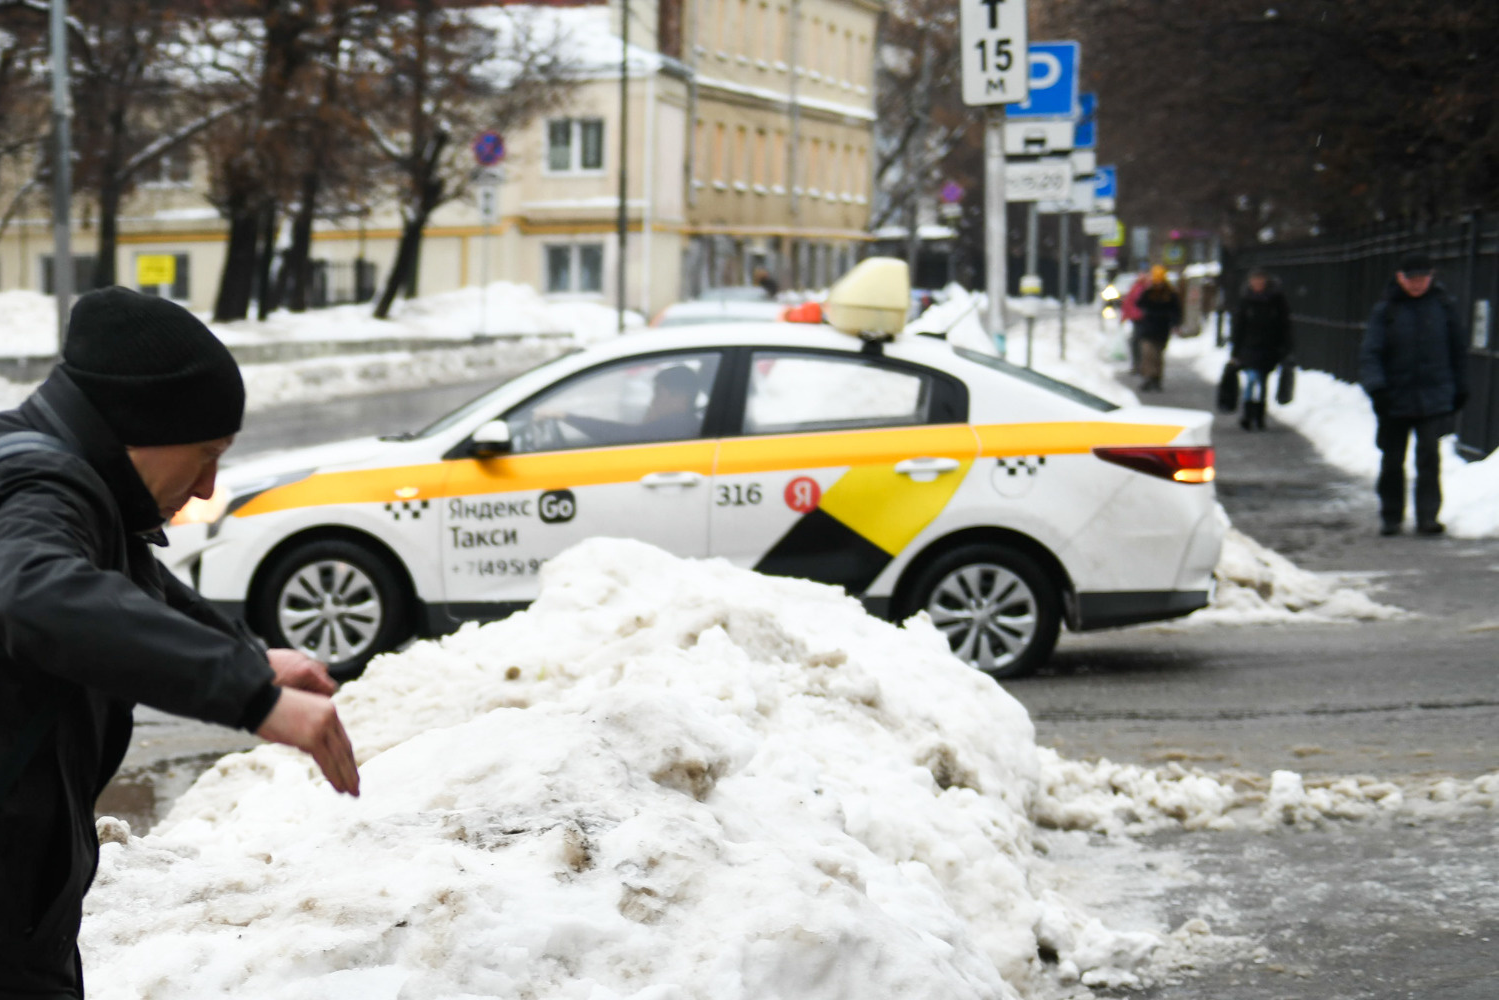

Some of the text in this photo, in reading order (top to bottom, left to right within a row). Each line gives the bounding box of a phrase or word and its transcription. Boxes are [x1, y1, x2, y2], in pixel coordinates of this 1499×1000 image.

[975, 37, 1013, 73] 15
[448, 494, 574, 521] Яндекс Go
[716, 482, 763, 507] 316
[793, 480, 813, 508] Я
[448, 526, 518, 549] Такси
